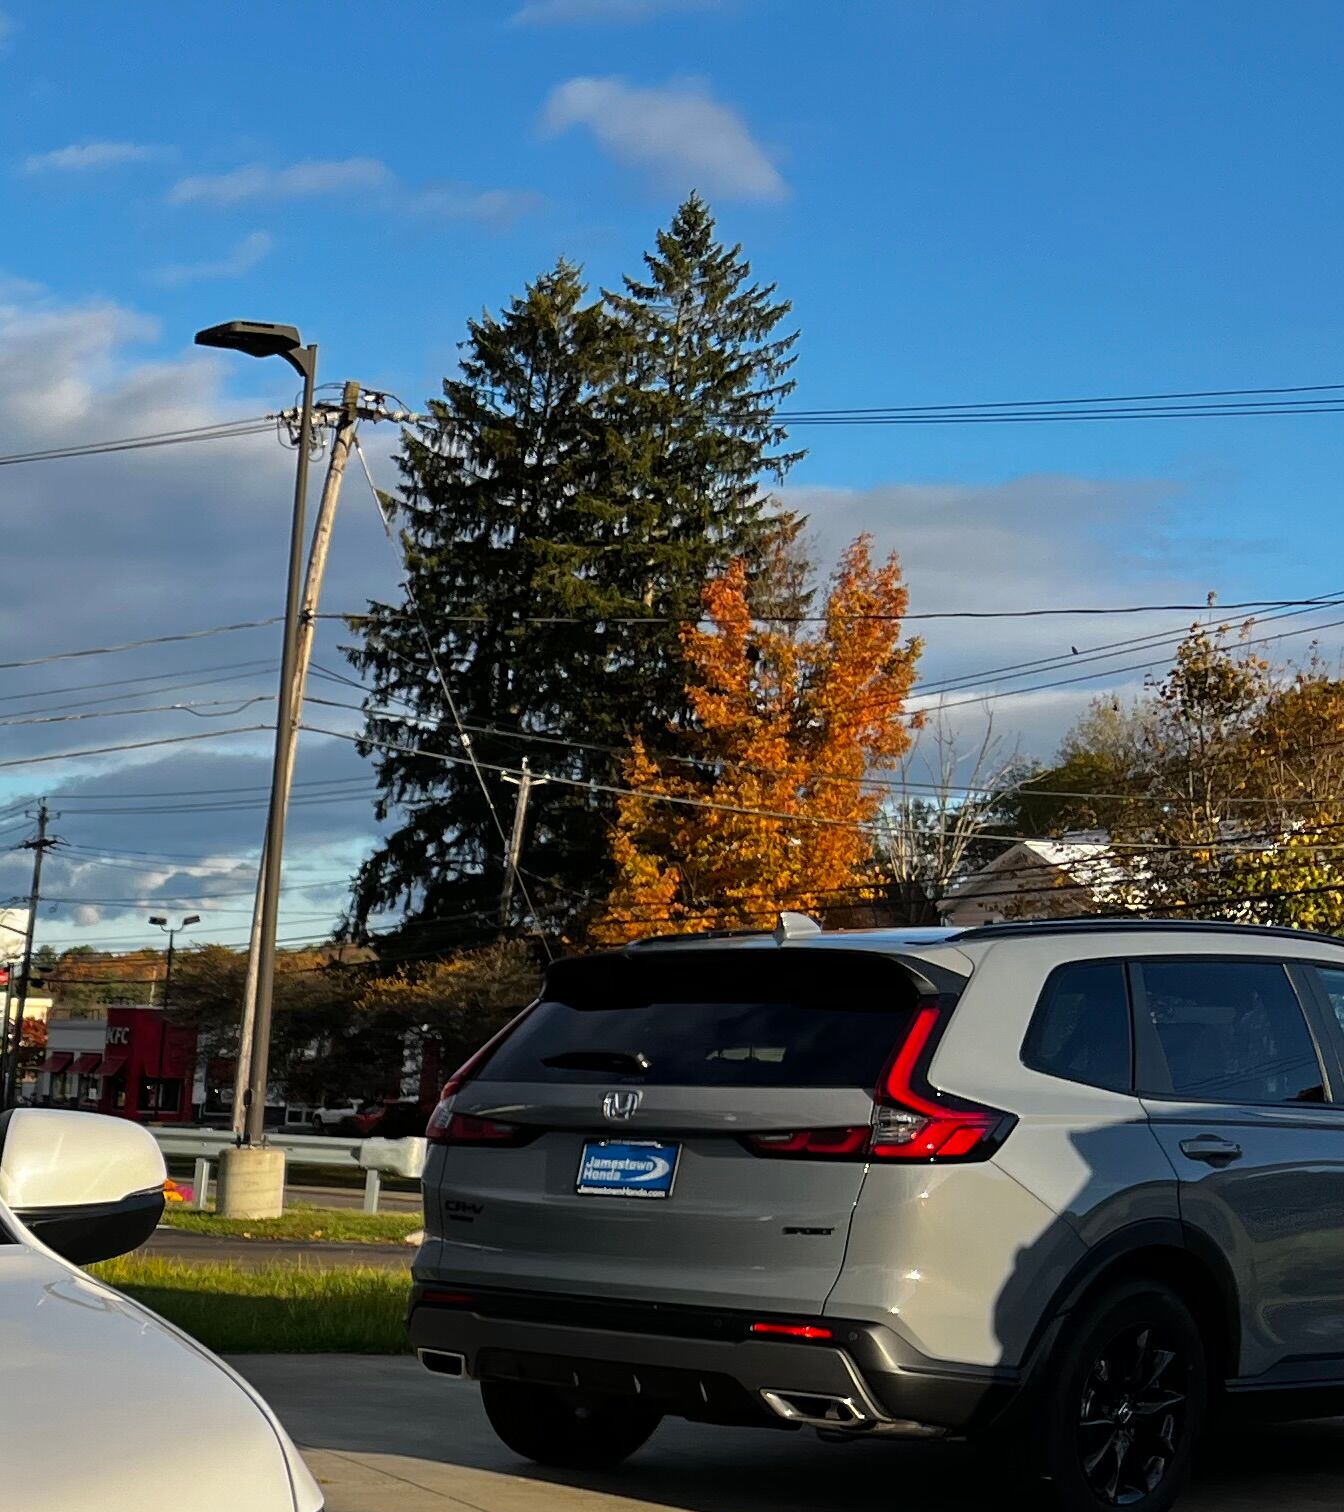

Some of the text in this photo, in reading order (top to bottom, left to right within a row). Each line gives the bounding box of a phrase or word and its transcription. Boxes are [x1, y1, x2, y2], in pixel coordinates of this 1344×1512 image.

[106, 1026, 130, 1045] KFC
[585, 1156, 654, 1171] Jamestown
[583, 1167, 622, 1181] Honda
[445, 1200, 484, 1214] CR-V
